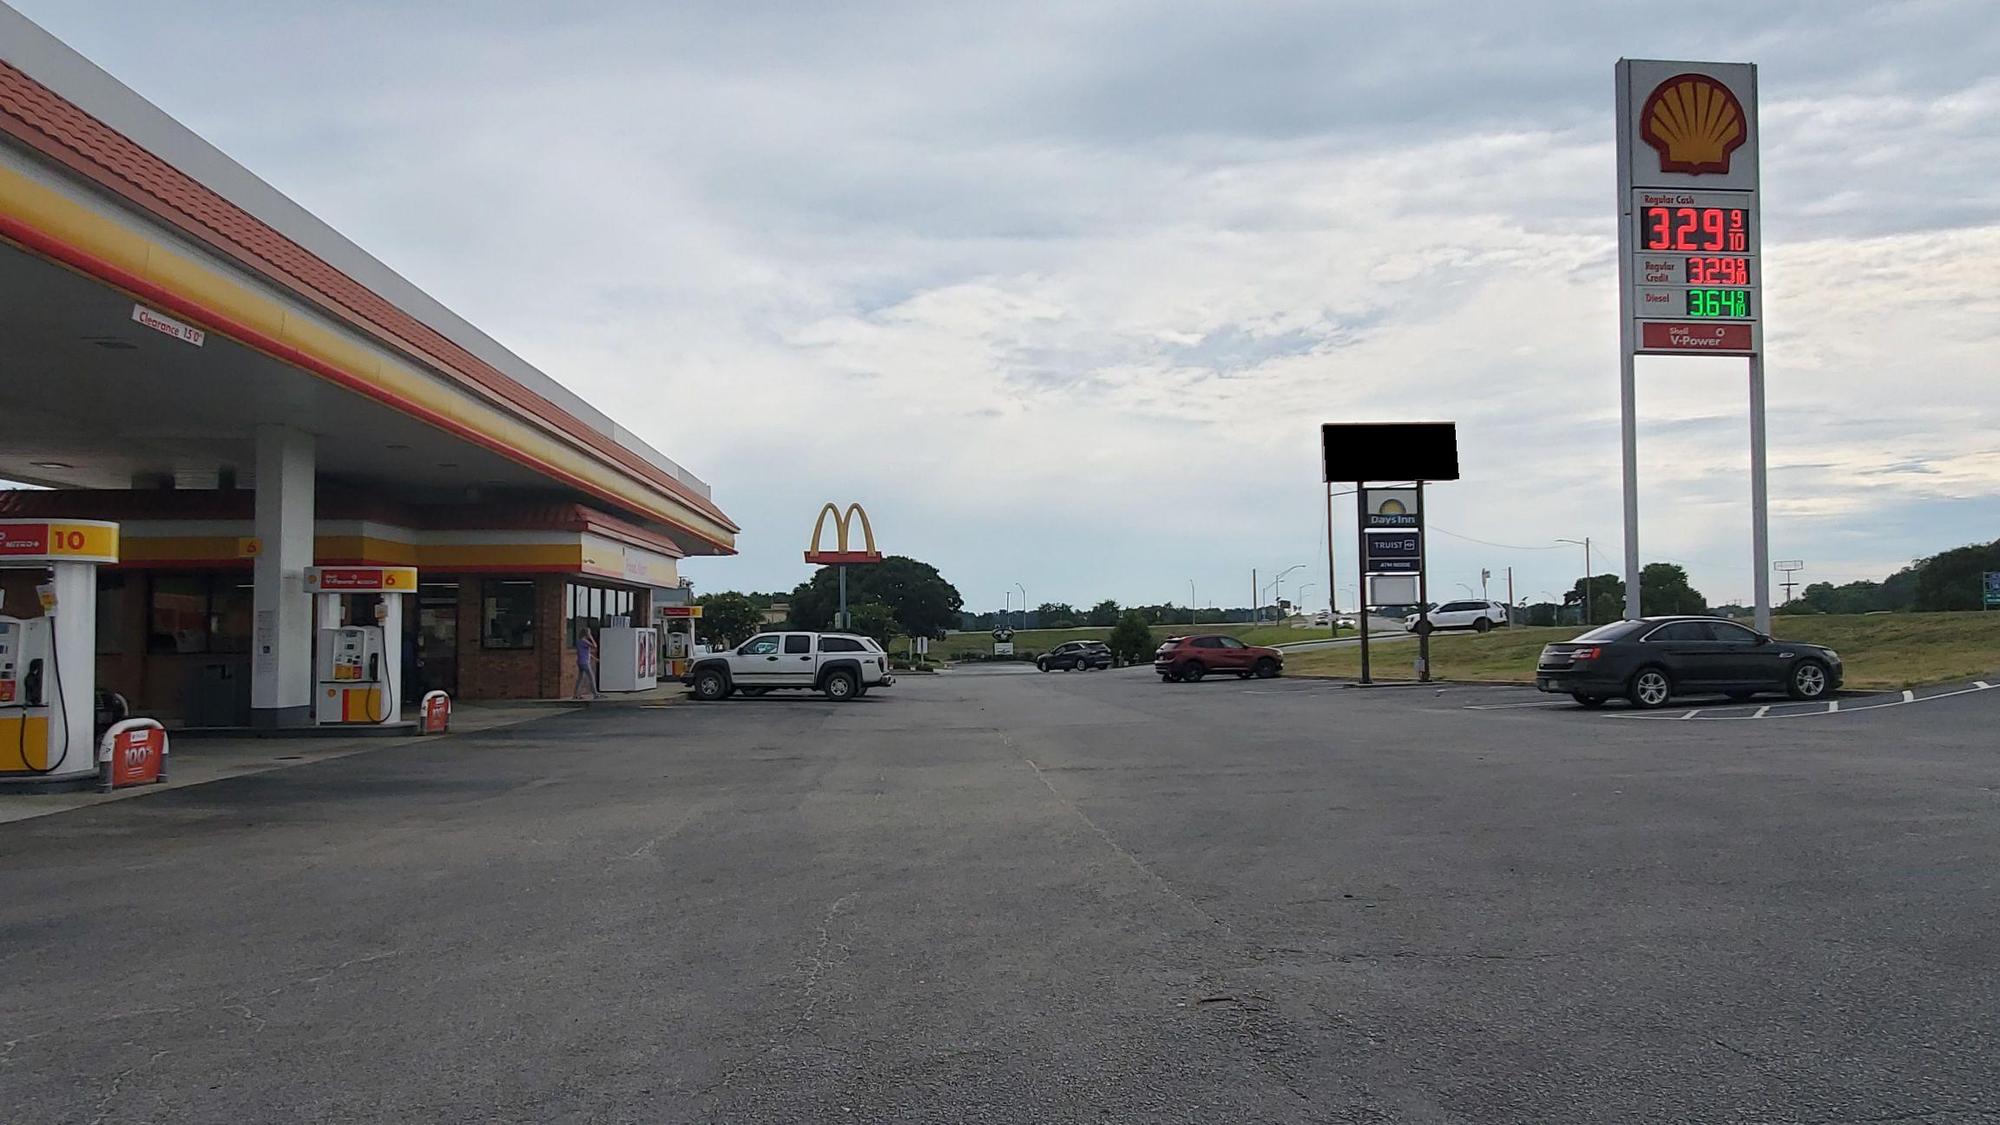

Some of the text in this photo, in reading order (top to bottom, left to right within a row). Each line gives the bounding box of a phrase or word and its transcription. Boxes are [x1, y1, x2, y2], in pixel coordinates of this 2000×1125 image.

[1644, 194, 1695, 205] Regular Cash
[1645, 261, 1675, 272] Regular
[1645, 293, 1670, 303] Diesel
[139, 311, 180, 336] Clearance
[1669, 327, 1689, 335] Shell
[1670, 336, 1721, 346] V-Power
[1371, 516, 1396, 524] Days
[55, 531, 85, 550] 10
[1374, 541, 1403, 549] TRUIST
[246, 541, 257, 553] 6
[385, 575, 396, 586] 6
